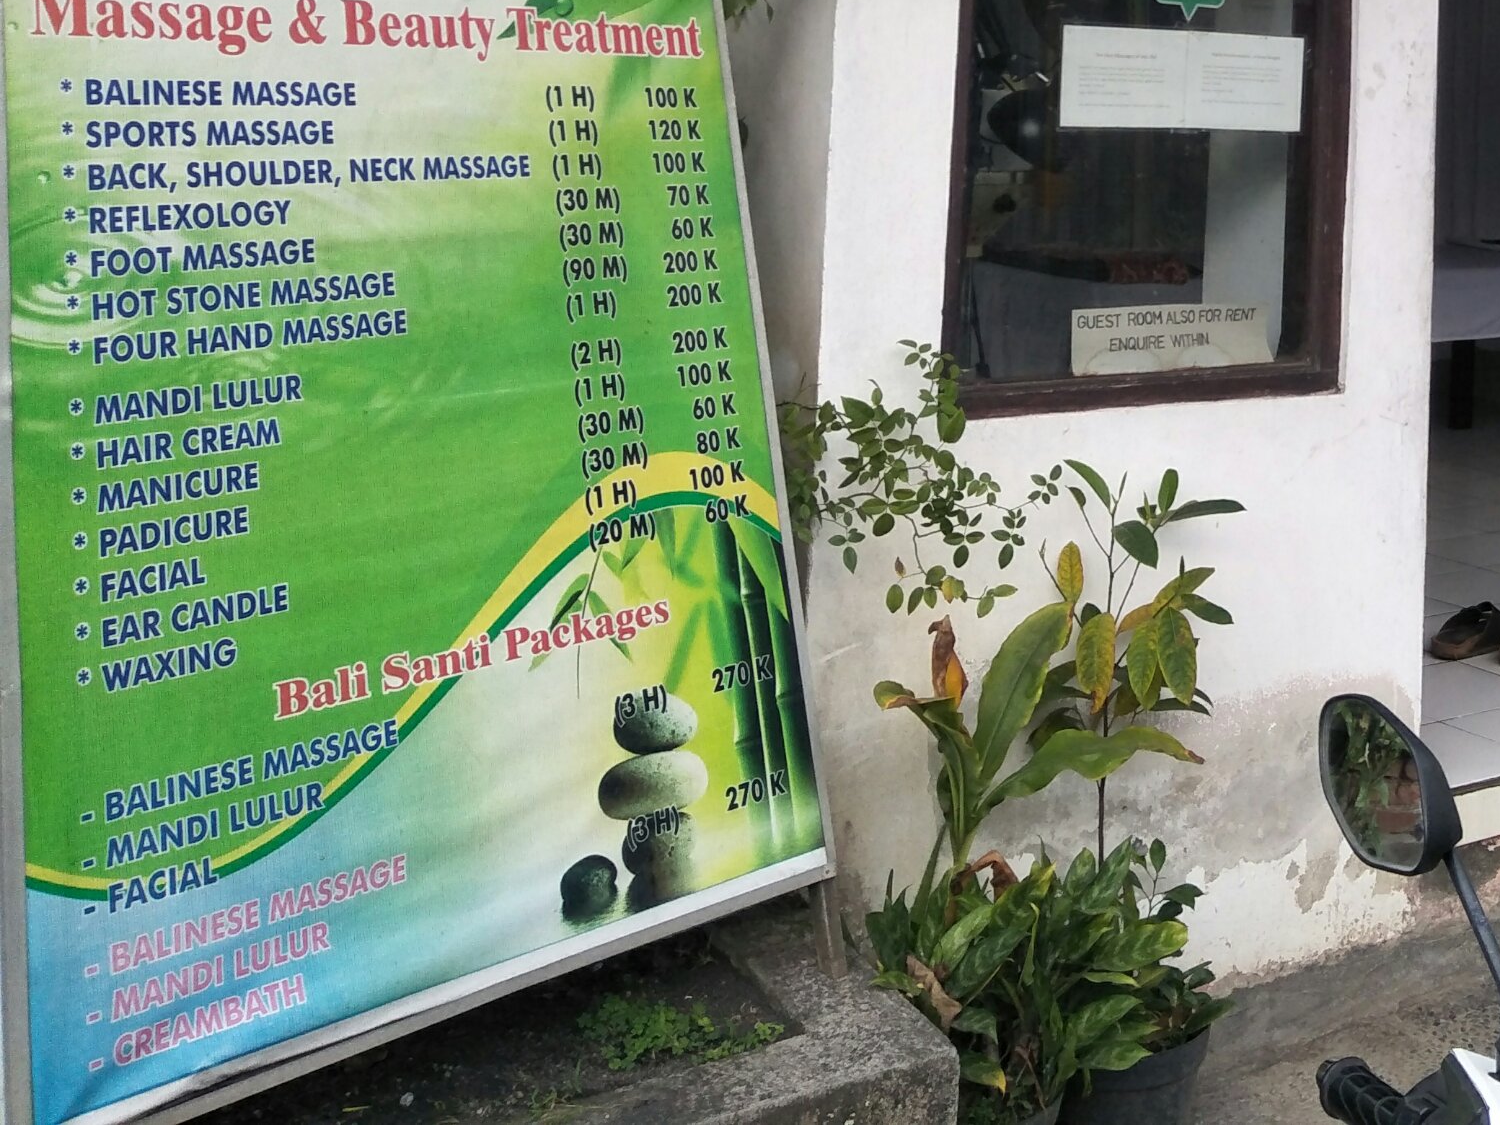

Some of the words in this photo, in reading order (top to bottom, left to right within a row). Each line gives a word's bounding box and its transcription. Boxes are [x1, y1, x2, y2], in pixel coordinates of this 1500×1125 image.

[505, 7, 704, 59] Treatment
[84, 79, 223, 107] BALINESE
[232, 81, 357, 108] MASSAGE
[546, 85, 562, 112] (1
[571, 86, 594, 112] H)
[645, 87, 677, 108] 100
[684, 88, 697, 108] K
[85, 120, 198, 149] SPORTS
[206, 119, 335, 148] MASSAGE
[549, 120, 566, 147] (1
[575, 120, 598, 146] H)
[648, 120, 682, 140] 120
[687, 120, 701, 140] K
[87, 162, 178, 193] BACK,
[187, 157, 341, 189] SHOULDER,
[348, 155, 416, 183] NECK
[422, 154, 531, 182] MASSAGE
[553, 154, 569, 182] (1
[578, 154, 601, 181] H)
[652, 152, 685, 173] 100
[692, 152, 705, 173] K
[556, 188, 588, 217] (30
[595, 187, 620, 214] M)
[667, 185, 690, 206] 70
[696, 185, 709, 205] K
[88, 200, 292, 235] REFLEXOLOGY
[560, 224, 591, 252] (30
[599, 221, 624, 248] M)
[671, 218, 694, 240] 60
[700, 217, 714, 238] K
[90, 246, 173, 277] FOOT
[181, 238, 316, 273] MASSAGE
[91, 292, 158, 321] HOT
[164, 281, 263, 315] STONE
[269, 272, 396, 309] MASSAGE
[92, 332, 178, 365] FOUR
[186, 321, 275, 357] HAND
[281, 309, 408, 347] MASSAGE
[1077, 313, 1121, 329] GUEST
[1127, 311, 1163, 326] ROOM
[1166, 310, 1195, 324] ALSO
[1199, 308, 1221, 323] FOR
[1224, 307, 1257, 322] RENT
[1109, 335, 1165, 352] ENQUIRE
[1169, 332, 1210, 348] WITHIN
[94, 384, 203, 426] MANDI
[210, 375, 303, 416] LULUR
[96, 434, 175, 470] HAIR
[181, 418, 281, 460] CREAM
[97, 463, 260, 515] MANICURE
[98, 506, 250, 559] PADICURE
[100, 557, 206, 602] FACIAL
[101, 614, 163, 649] EAR
[170, 584, 290, 638] CANDLE
[102, 640, 238, 693] WAXING
[272, 662, 369, 723] Bali
[380, 632, 493, 697] Santi
[505, 597, 671, 667] Packages
[104, 754, 256, 824] BALINESE
[262, 719, 400, 782] MASSAGE
[106, 810, 220, 870] MANDI
[227, 781, 326, 839] LULUR
[106, 856, 219, 915] FACIAL
[108, 898, 261, 976] BALINESE
[266, 854, 408, 922] MASSAGE
[111, 962, 228, 1023] MANDI
[233, 922, 331, 982] LULUR
[114, 974, 307, 1069] CREAMBATH
